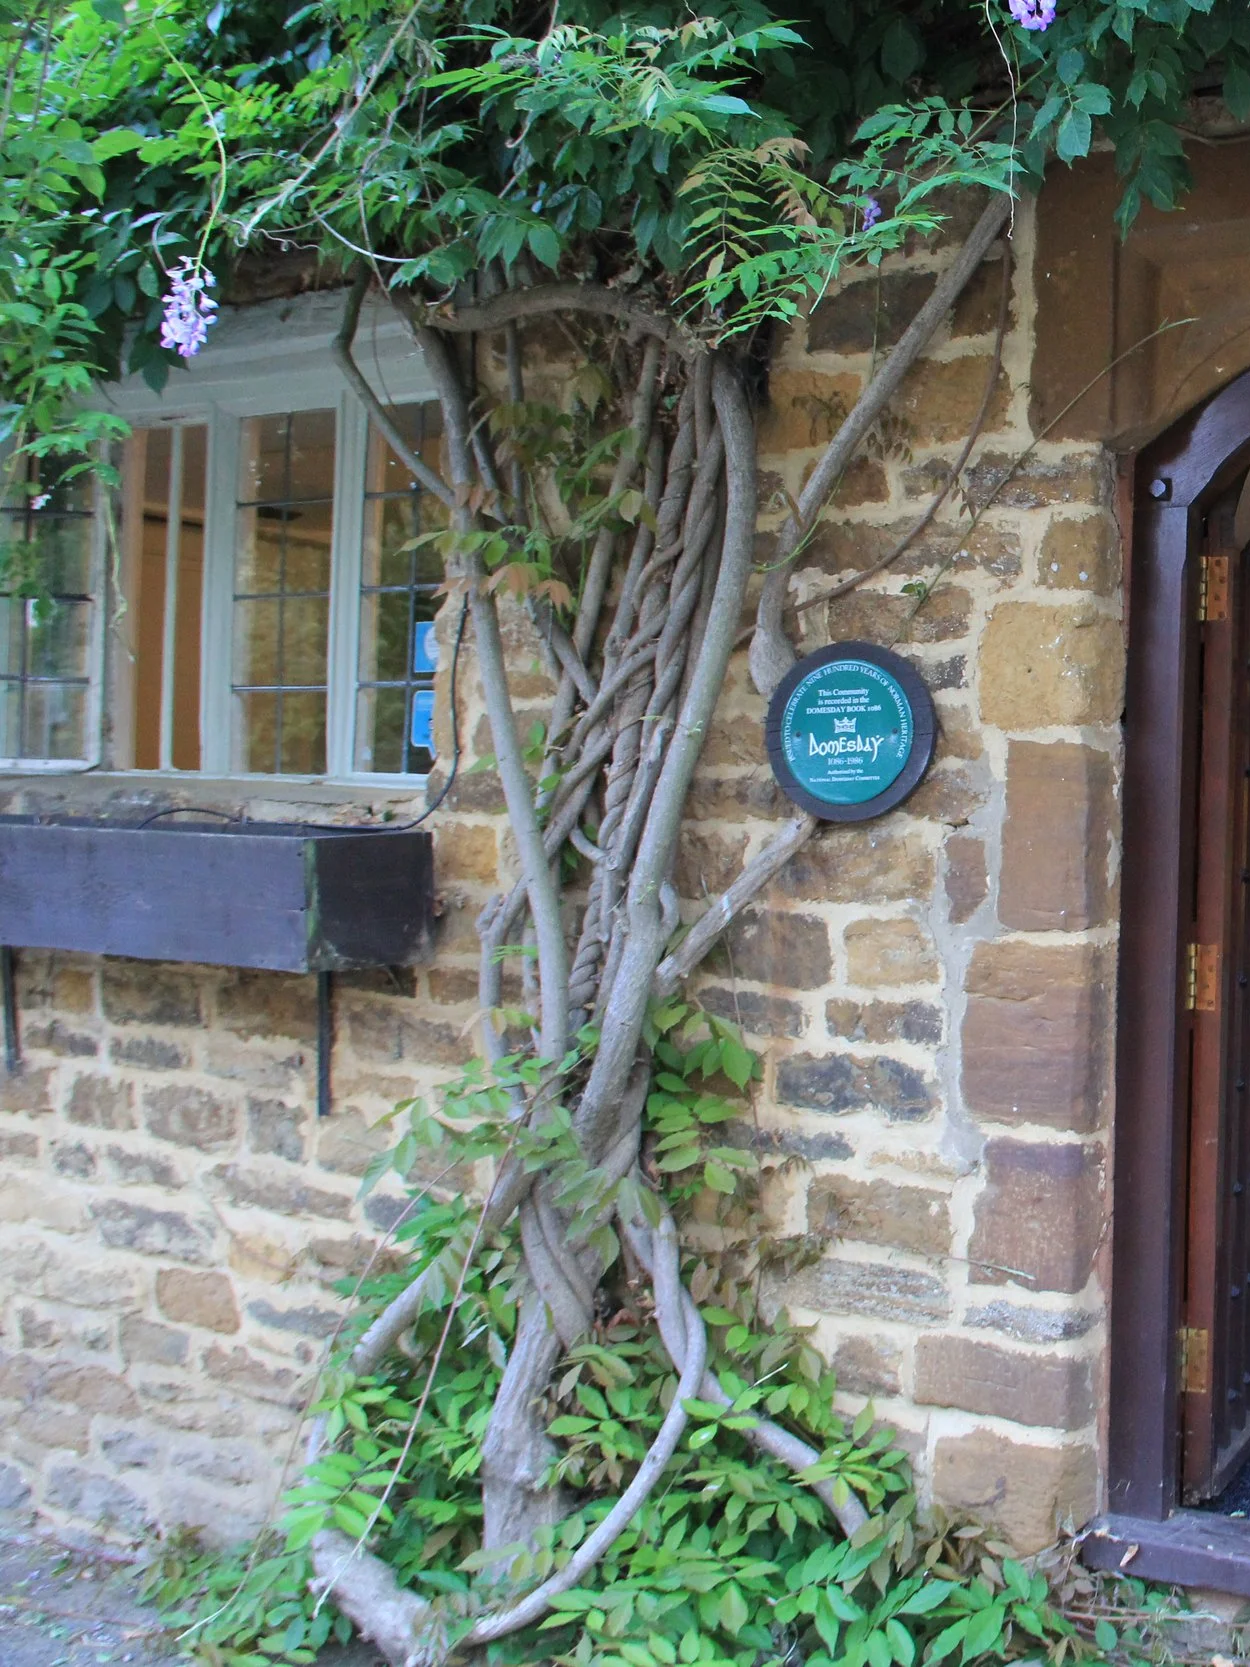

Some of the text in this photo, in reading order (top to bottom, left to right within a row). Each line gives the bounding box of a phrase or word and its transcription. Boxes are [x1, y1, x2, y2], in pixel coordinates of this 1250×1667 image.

[824, 665, 859, 675] HUNDRED
[860, 666, 881, 680] YEARS
[807, 673, 823, 686] NINE
[880, 678, 889, 686] OF
[833, 688, 869, 696] Community
[785, 686, 808, 725] CELEBRATE
[824, 697, 852, 705] recorded
[887, 685, 906, 718] NORMAN
[806, 704, 882, 715] DOMESDAY BOOK 1086
[896, 718, 908, 759] HERITAGE
